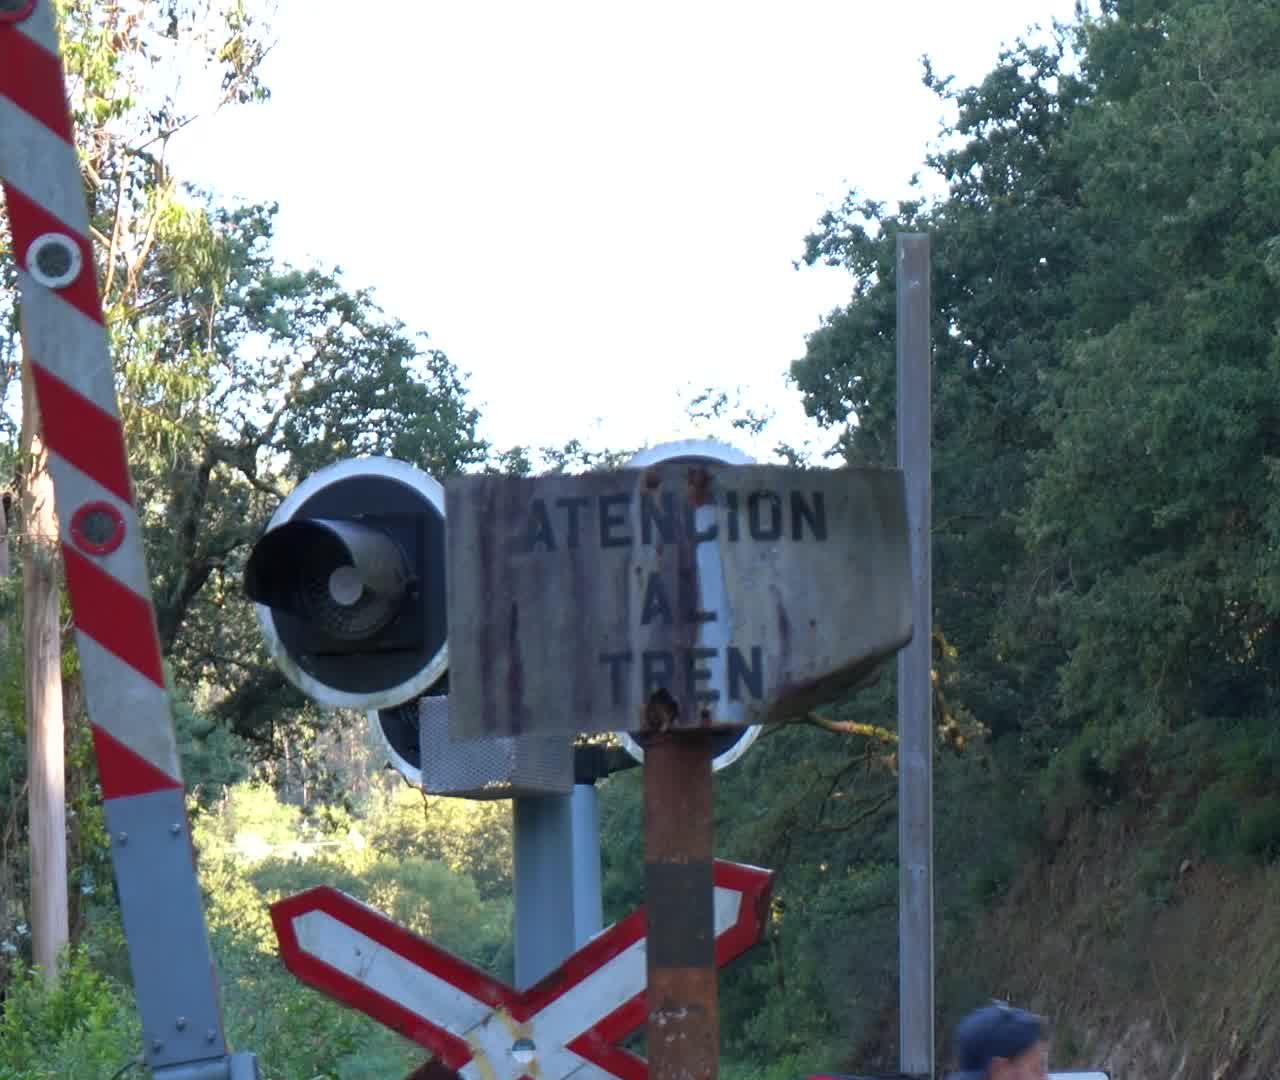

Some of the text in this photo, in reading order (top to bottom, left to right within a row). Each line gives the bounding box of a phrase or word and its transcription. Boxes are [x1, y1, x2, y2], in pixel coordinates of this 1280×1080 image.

[526, 490, 828, 552] ATENCION
[640, 570, 718, 626] AL
[599, 646, 764, 706] TREN
